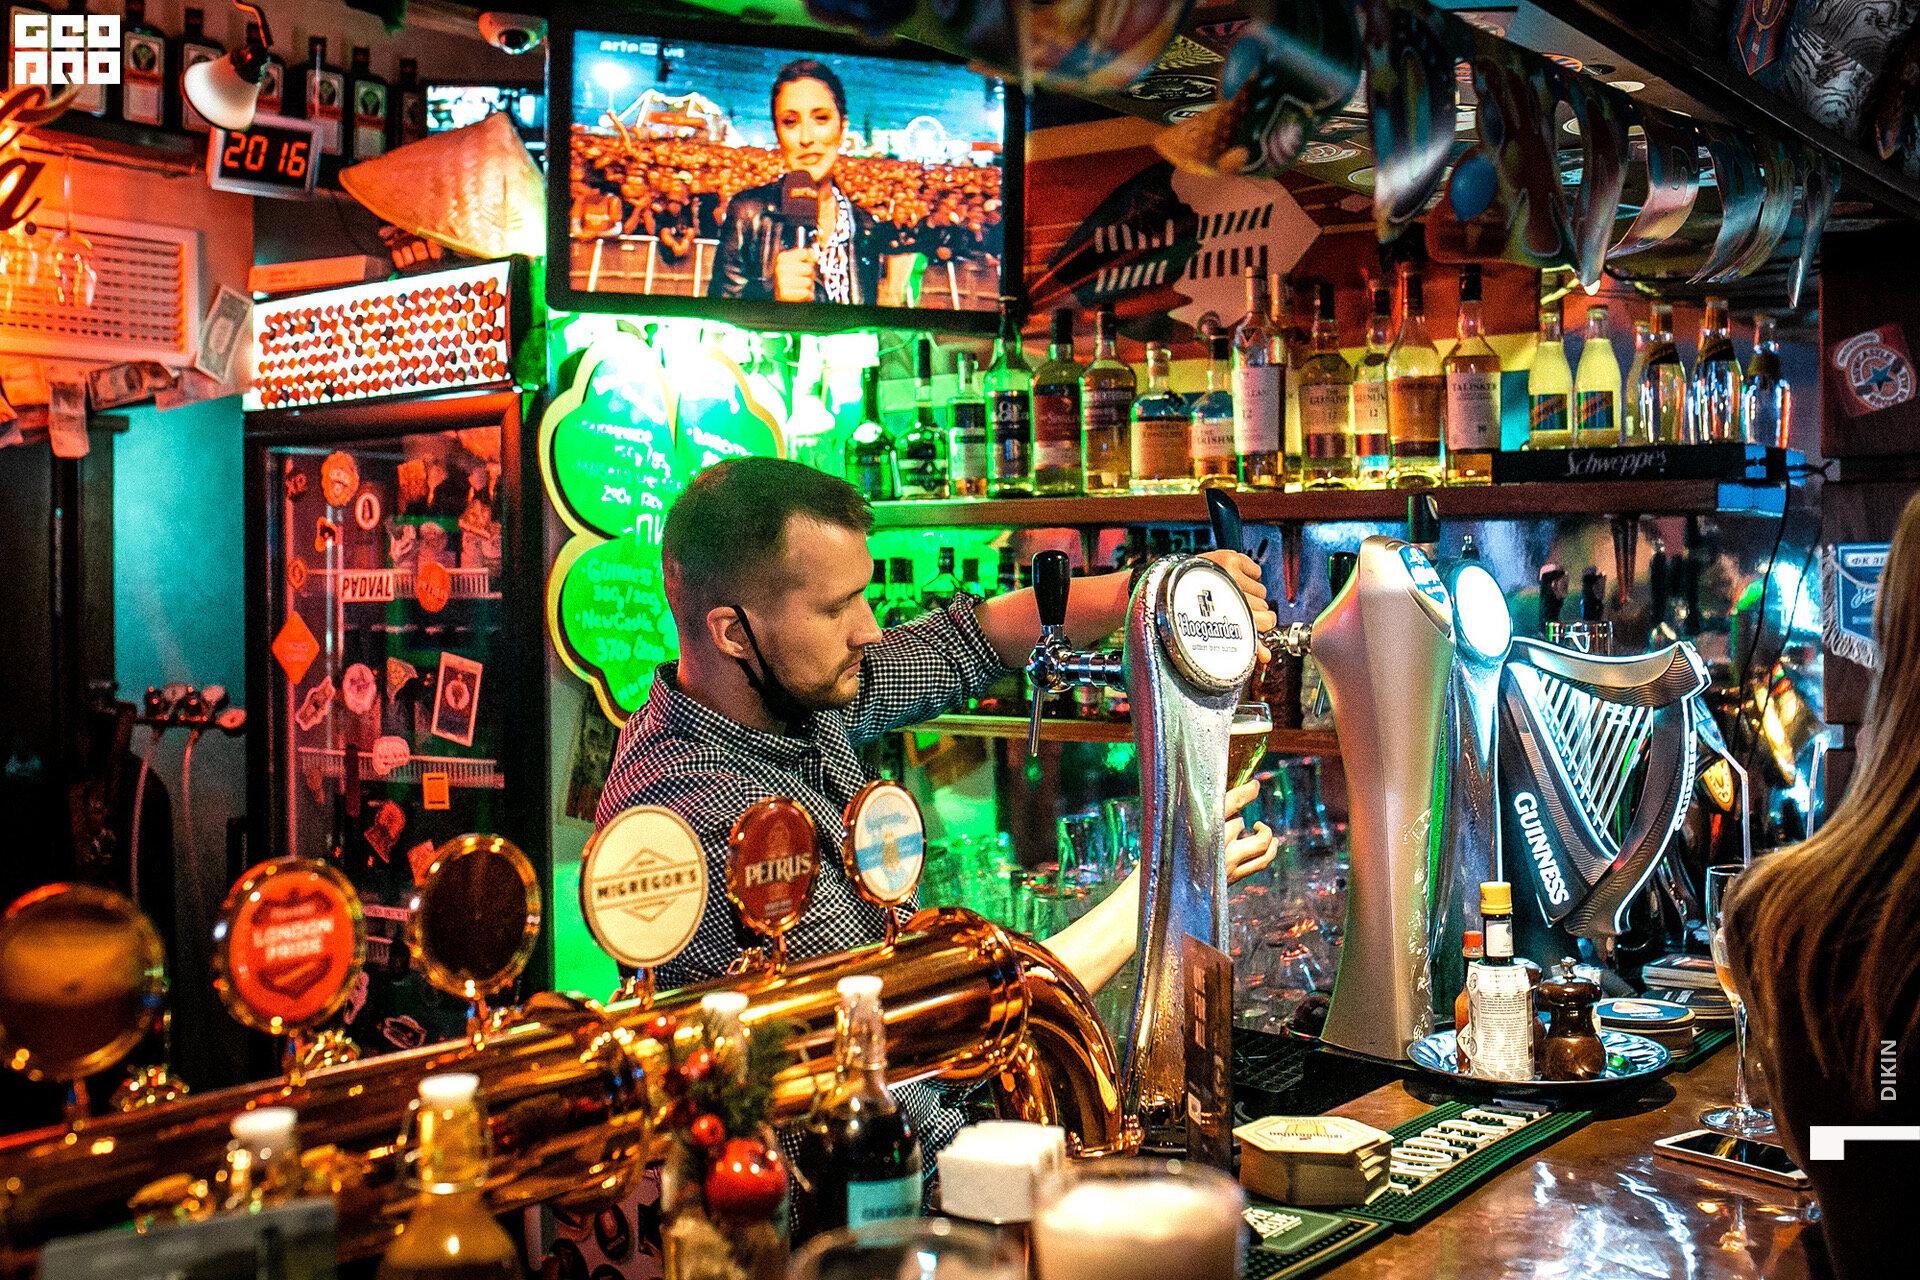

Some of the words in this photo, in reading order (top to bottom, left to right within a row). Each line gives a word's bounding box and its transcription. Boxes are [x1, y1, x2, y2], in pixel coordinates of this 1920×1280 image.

[1178, 612, 1243, 642] Hoegaarden
[1513, 791, 1570, 906] GUINNESS
[744, 853, 813, 889] PETRUS
